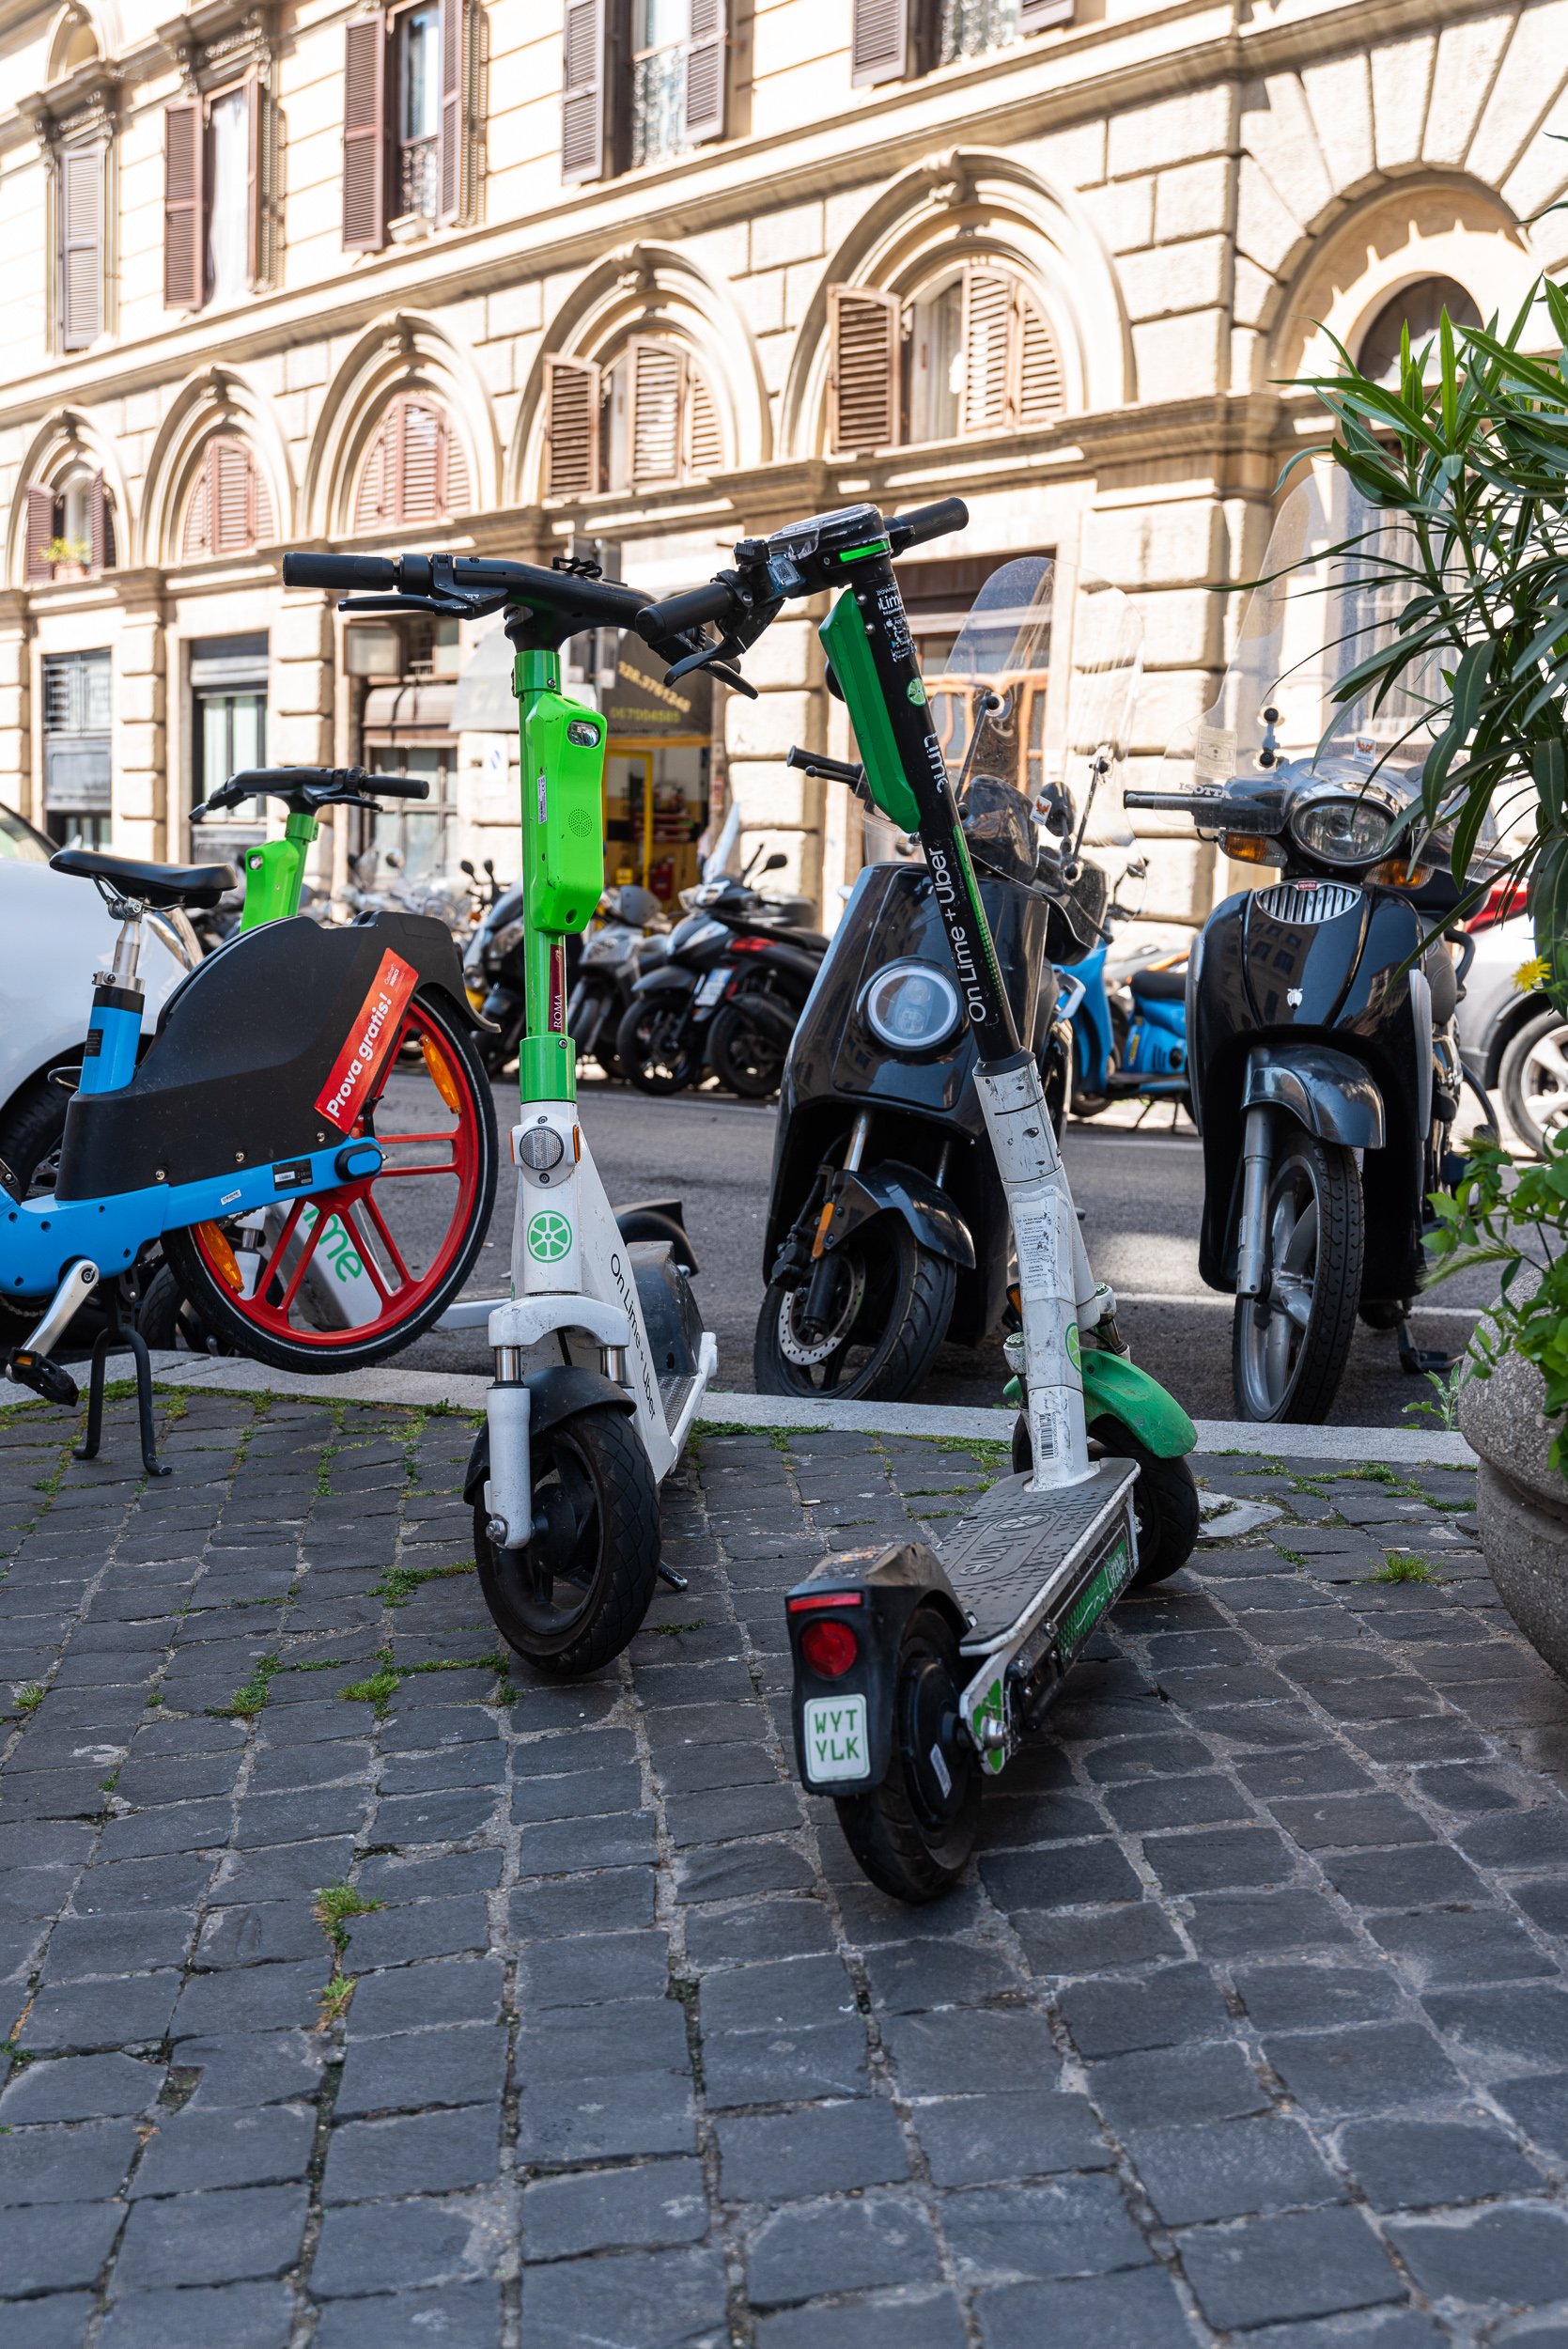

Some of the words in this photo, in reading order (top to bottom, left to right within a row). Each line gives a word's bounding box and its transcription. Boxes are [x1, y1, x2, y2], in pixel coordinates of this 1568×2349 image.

[1179, 782, 1233, 800] ISOTTA
[928, 847, 955, 904] Uber
[945, 908, 956, 922] +
[951, 926, 978, 983] Lime
[552, 994, 563, 1029] ROMA
[967, 987, 986, 1022] On
[325, 1059, 364, 1119] Prova
[358, 992, 392, 1062] gratis!
[302, 1207, 363, 1283] ime
[611, 1253, 625, 1294] On
[623, 1288, 641, 1348] Lime
[643, 1362, 656, 1421] Uber
[959, 1534, 1031, 1577] Lime
[815, 1709, 859, 1735] WYT
[815, 1736, 861, 1763] YLK
